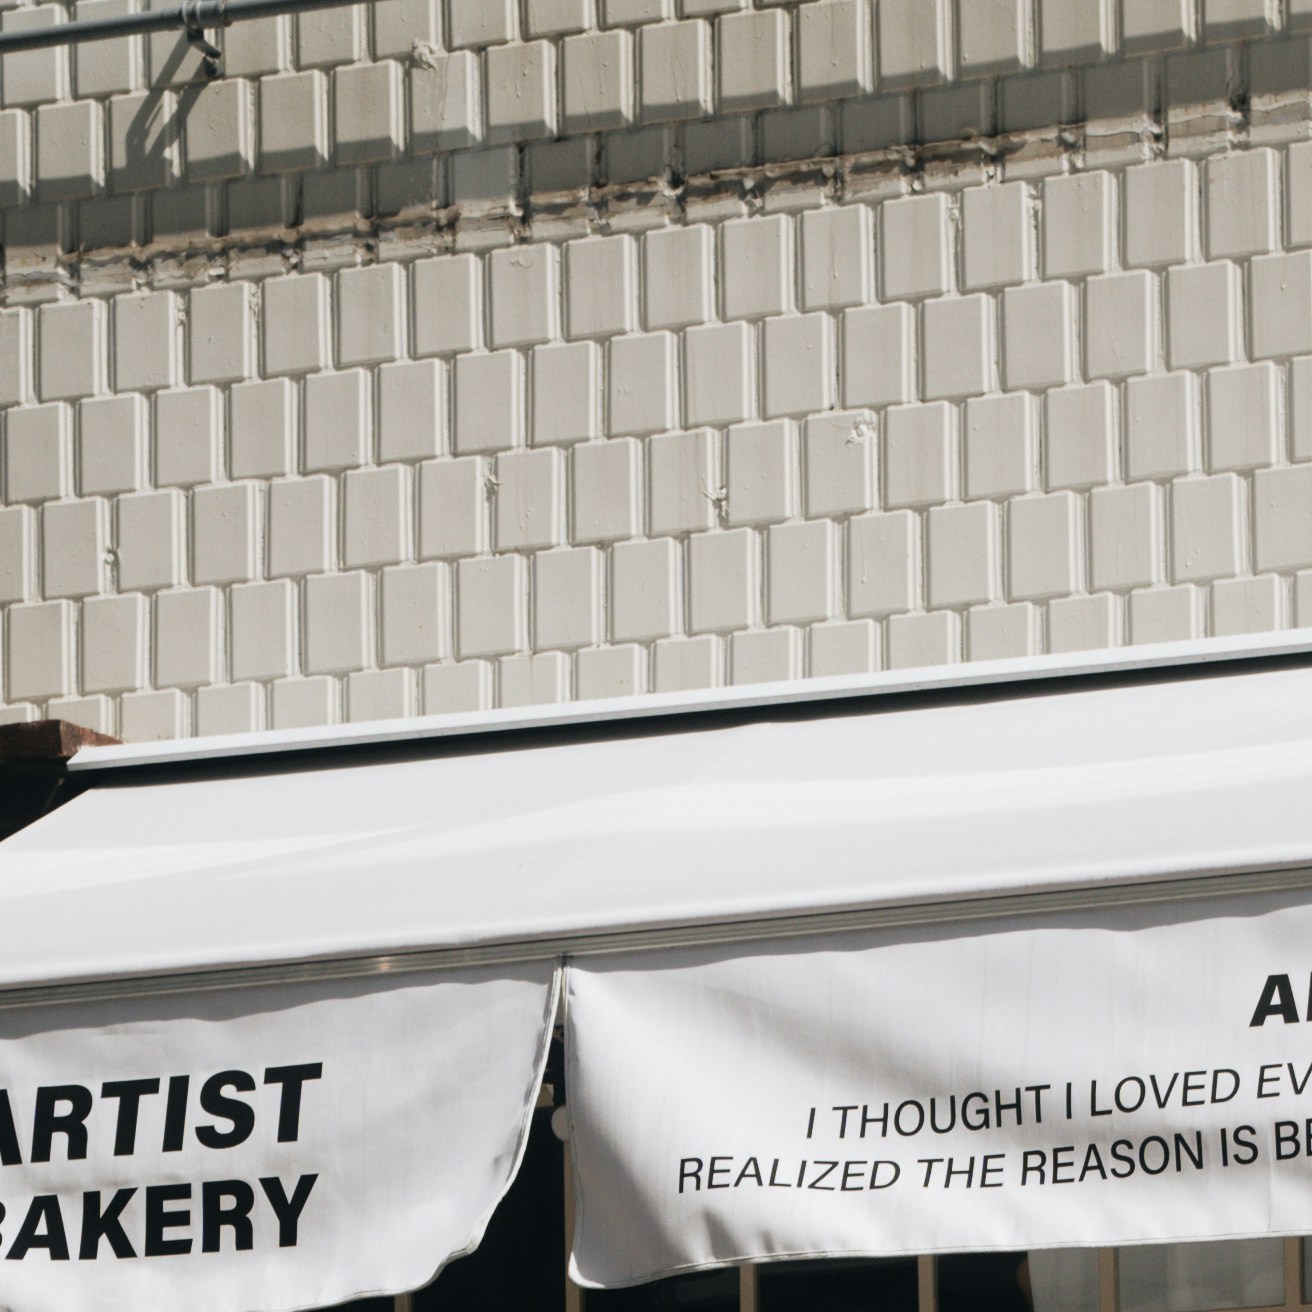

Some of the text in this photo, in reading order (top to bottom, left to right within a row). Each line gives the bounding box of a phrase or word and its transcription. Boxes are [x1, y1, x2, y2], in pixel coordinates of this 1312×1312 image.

[806, 1107, 816, 1138] I
[832, 1084, 1051, 1139] THOUGHT
[1066, 1082, 1072, 1120] I
[1090, 1068, 1240, 1117] LOVED
[678, 1156, 901, 1194] REALIZED
[917, 1153, 1006, 1188] THE
[1021, 1130, 1204, 1186] REASON
[1220, 1124, 1259, 1167] IS
[0, 1173, 319, 1261] AKERY
